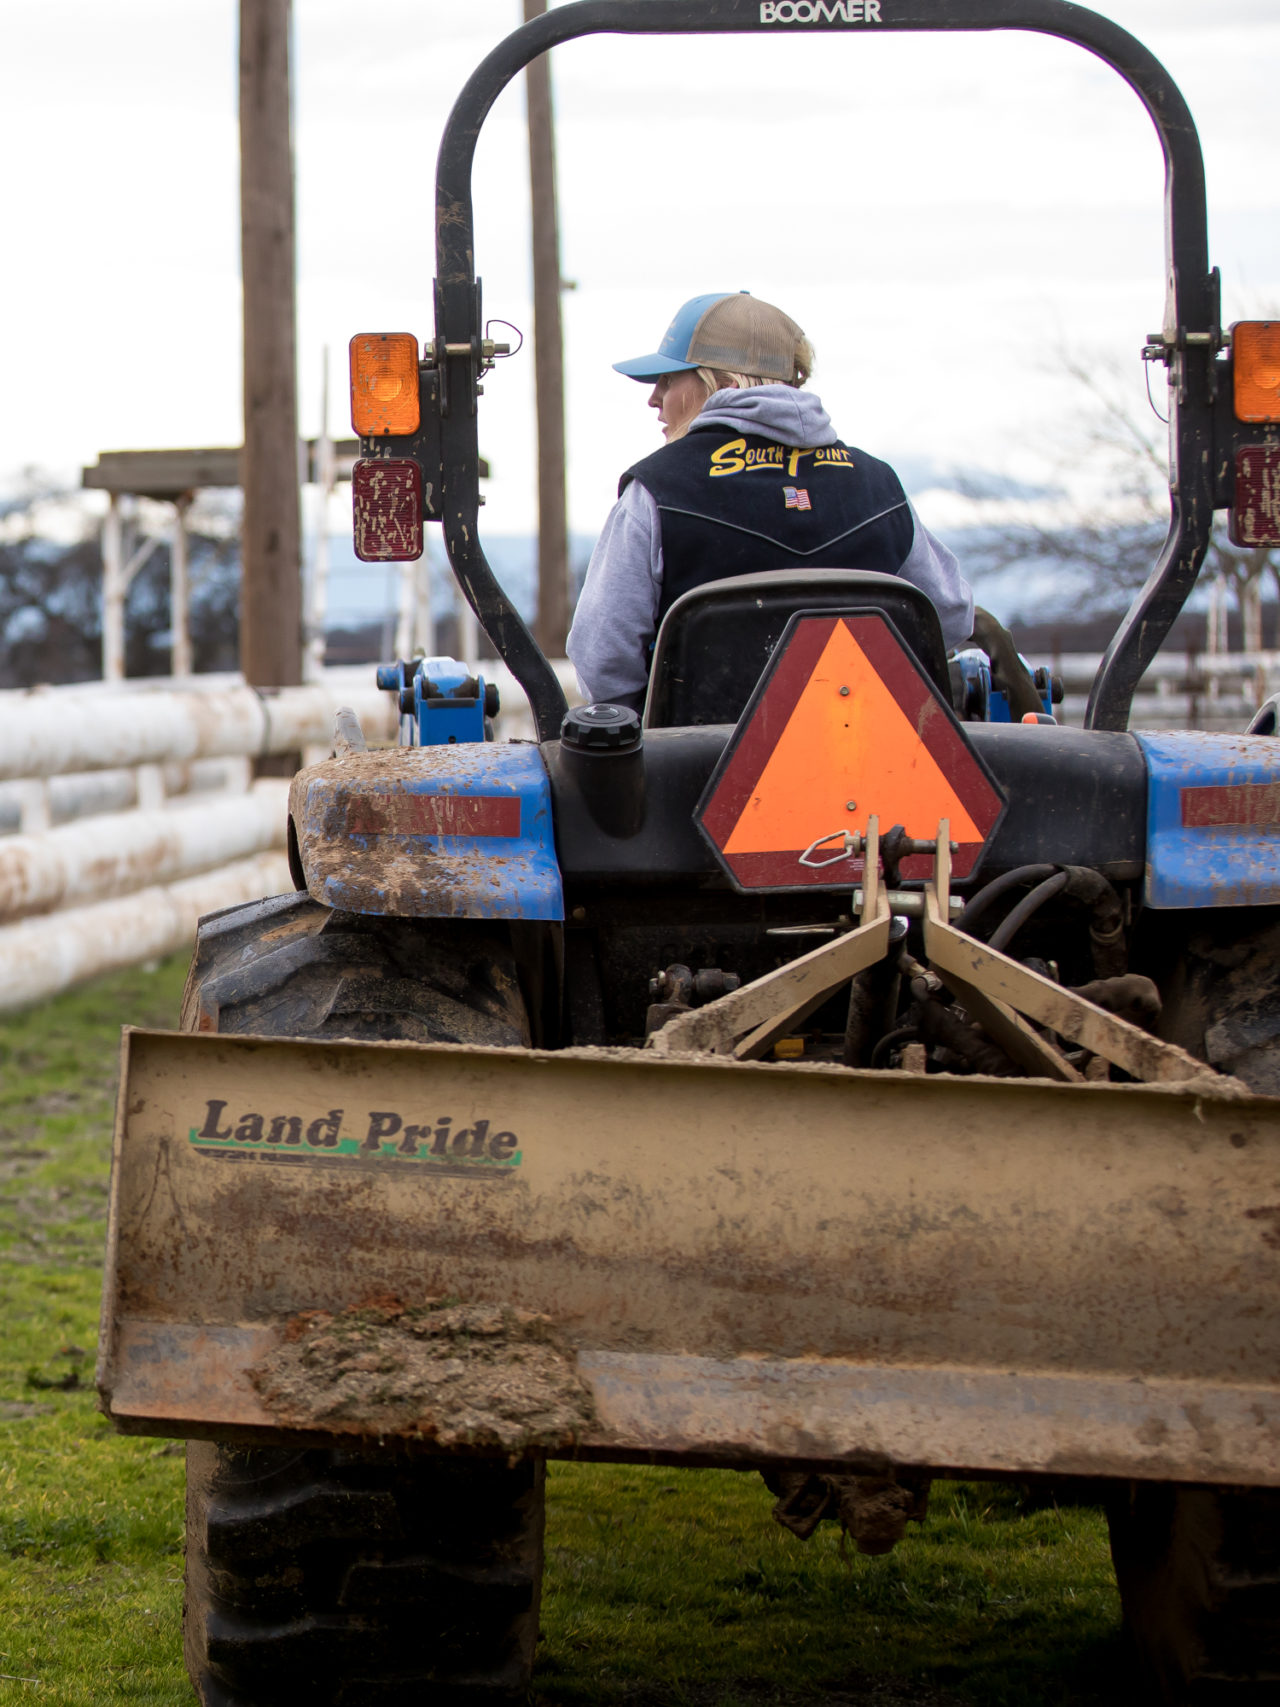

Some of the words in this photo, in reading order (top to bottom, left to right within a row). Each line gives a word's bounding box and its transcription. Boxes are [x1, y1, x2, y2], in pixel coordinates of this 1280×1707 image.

[759, 0, 882, 24] BOOMER
[709, 438, 784, 477] SOUTH
[197, 1098, 345, 1148] Land
[360, 1111, 519, 1161] Pride
